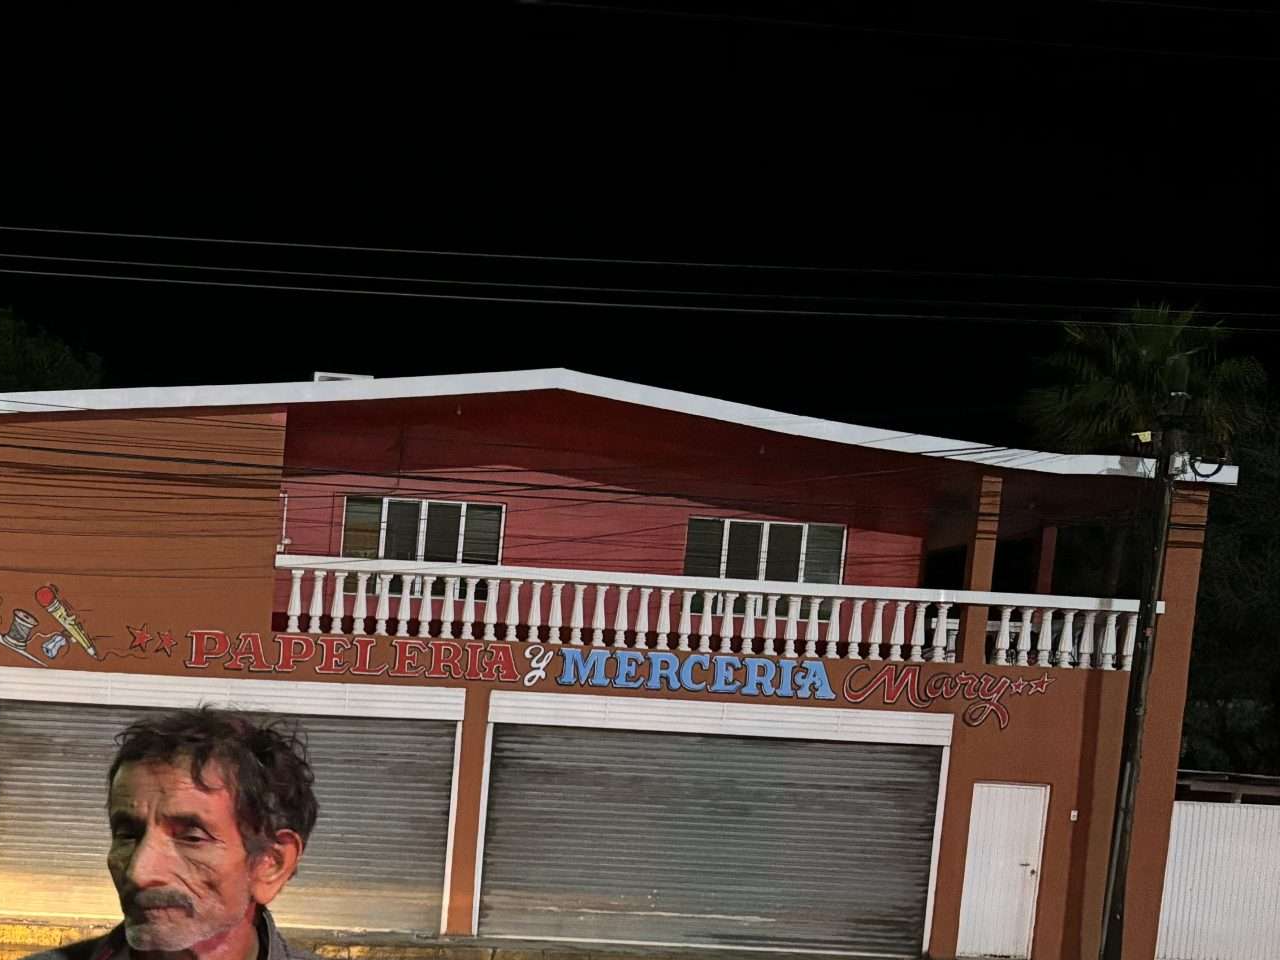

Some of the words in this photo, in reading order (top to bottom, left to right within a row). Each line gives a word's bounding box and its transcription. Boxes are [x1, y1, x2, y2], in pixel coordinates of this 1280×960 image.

[183, 629, 521, 683] PAPELERIA
[556, 646, 837, 701] MERCERIA
[843, 663, 1010, 729] Mary
